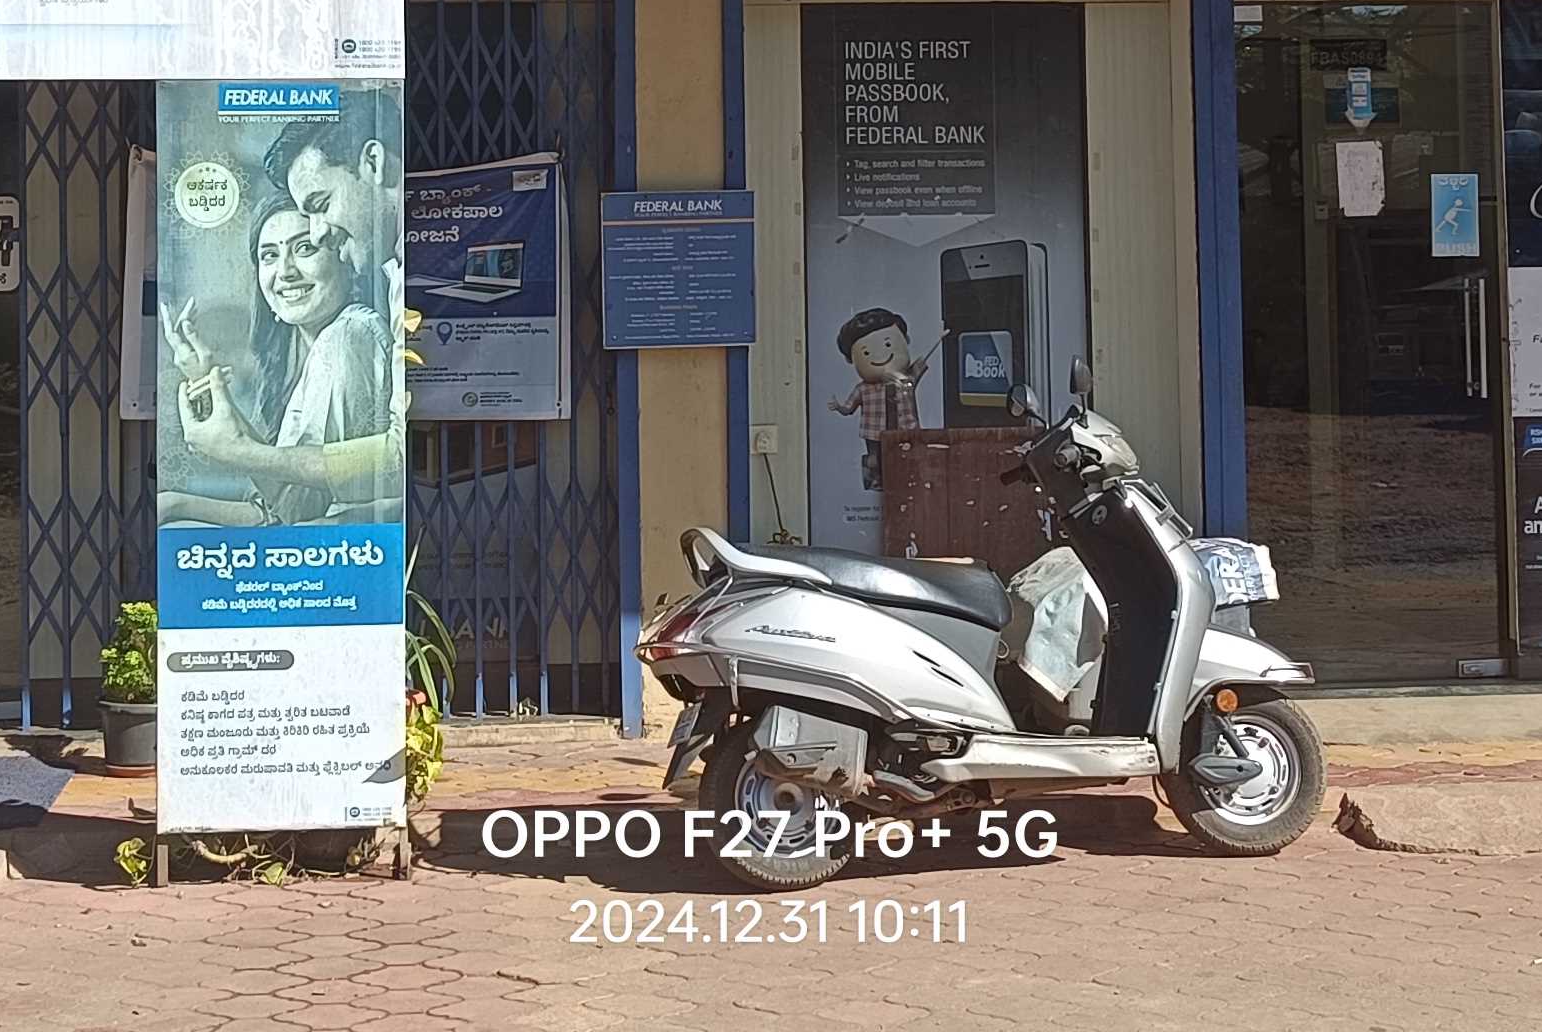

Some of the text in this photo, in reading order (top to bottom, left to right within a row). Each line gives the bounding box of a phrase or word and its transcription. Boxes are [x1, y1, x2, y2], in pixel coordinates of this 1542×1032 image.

[844, 41, 971, 59] INDIA'S FIRST
[844, 63, 915, 81] MOBILE
[224, 89, 334, 106] FEDERAL BANK
[844, 84, 950, 104] PASSBOOK,
[845, 105, 899, 123] FROM
[845, 126, 986, 145] FEDERAL BANK
[872, 159, 899, 169] search
[900, 159, 915, 169] and
[937, 159, 985, 168] transactions
[633, 199, 723, 213] FEDERAL BANK
[177, 539, 384, 579] ಚಿನ್ನದ ಸಾಲಗಳು
